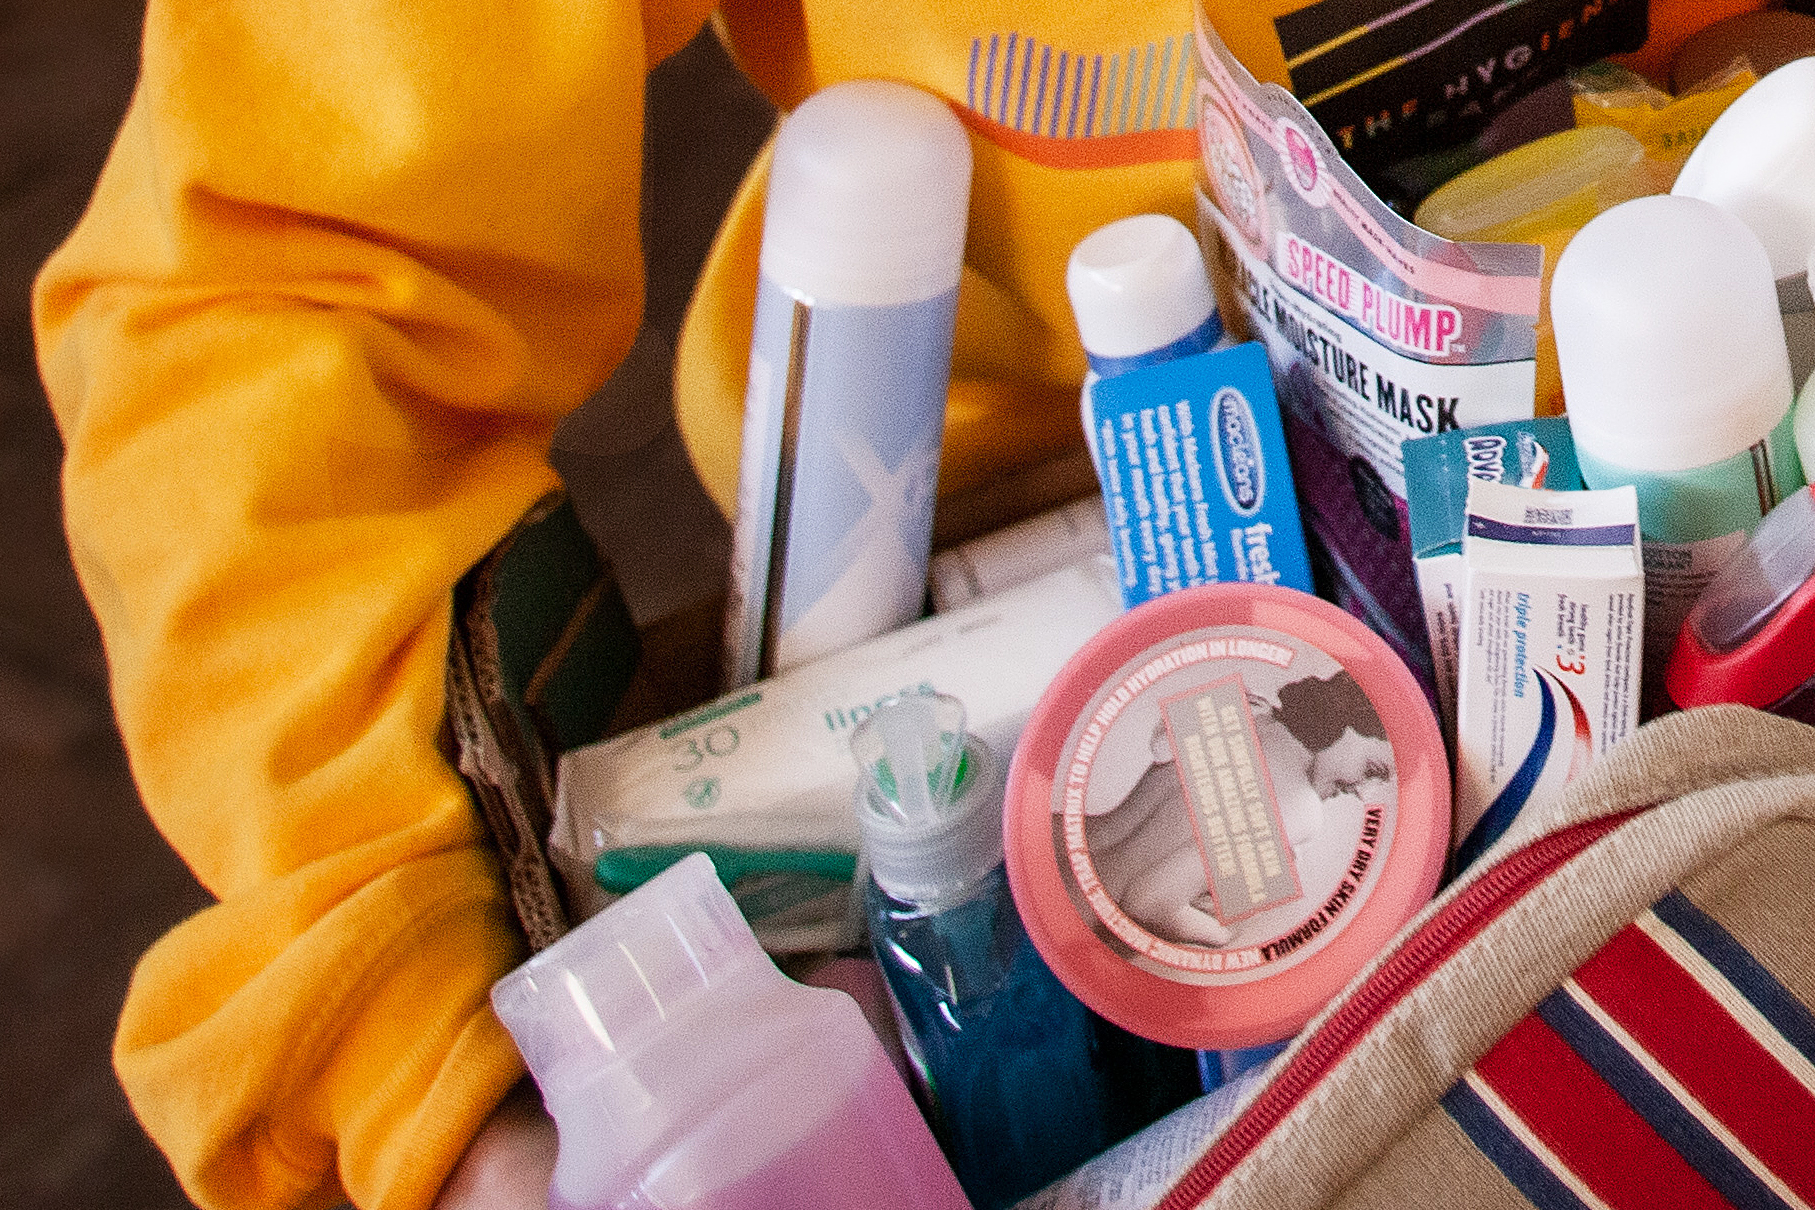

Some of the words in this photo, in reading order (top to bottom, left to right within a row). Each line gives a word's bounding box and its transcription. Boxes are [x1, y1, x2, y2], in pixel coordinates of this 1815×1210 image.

[1337, 98, 1420, 150] THE
[1286, 238, 1351, 310] SPEED
[1361, 280, 1457, 352] PLUMP
[1274, 300, 1370, 401] MOISTURE
[1376, 372, 1459, 433] MASK
[1142, 410, 1156, 445] fresh
[1159, 406, 1179, 470] confident
[1177, 402, 1192, 436] With
[1123, 431, 1140, 464] your
[1147, 448, 1162, 474] and
[1221, 397, 1256, 503] macleans
[1171, 472, 1185, 501] that
[1184, 437, 1202, 501] Macleans
[1133, 469, 1150, 517] mouth
[1141, 520, 1156, 561] every
[1173, 504, 1190, 535] your
[1196, 503, 1211, 540] Fresh
[1183, 538, 1198, 576] teeth
[1203, 542, 1217, 575] Mint
[1515, 593, 1529, 628] triple
[1124, 641, 1209, 694] HYDRATION
[1208, 639, 1227, 658] IN
[1513, 630, 1527, 698] protection
[1094, 684, 1132, 726] HOLD
[670, 724, 741, 771] 30
[1075, 720, 1106, 762] HELP
[1067, 760, 1088, 784] TO
[1221, 706, 1240, 731] GET
[1248, 802, 1270, 837] SOFT
[1064, 785, 1085, 851] MATRIX
[1358, 806, 1383, 849] VERY
[1346, 848, 1374, 883] DRY
[1321, 878, 1358, 920] SKIN
[1258, 909, 1331, 963] FORMULA
[1223, 948, 1261, 971] NEW
